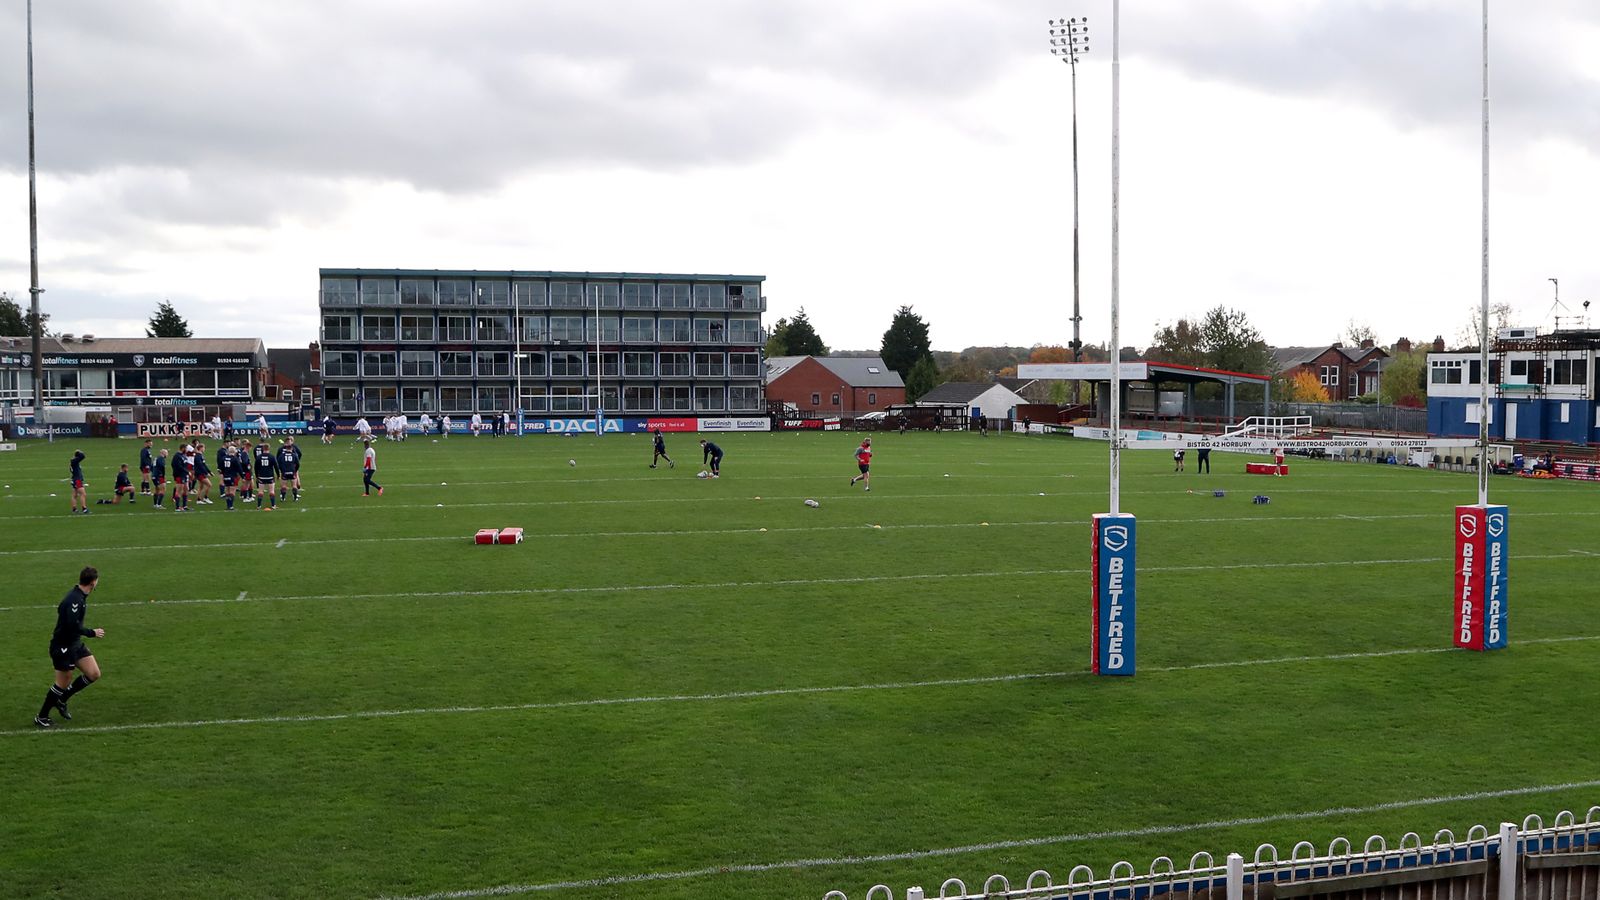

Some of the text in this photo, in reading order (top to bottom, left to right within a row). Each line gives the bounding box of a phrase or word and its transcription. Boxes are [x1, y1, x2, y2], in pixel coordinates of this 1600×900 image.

[41, 356, 79, 365] totalfitness
[152, 356, 198, 365] totalfitness
[154, 398, 197, 406] totalfitness
[509, 422, 545, 431] BTFRED
[549, 418, 620, 432] DACA
[26, 426, 82, 435] bartercrd.co.uk
[223, 460, 231, 468] 10
[1460, 542, 1473, 644] BETFRED
[1489, 542, 1501, 644] BETFRED
[1108, 557, 1124, 669] BETFRED
